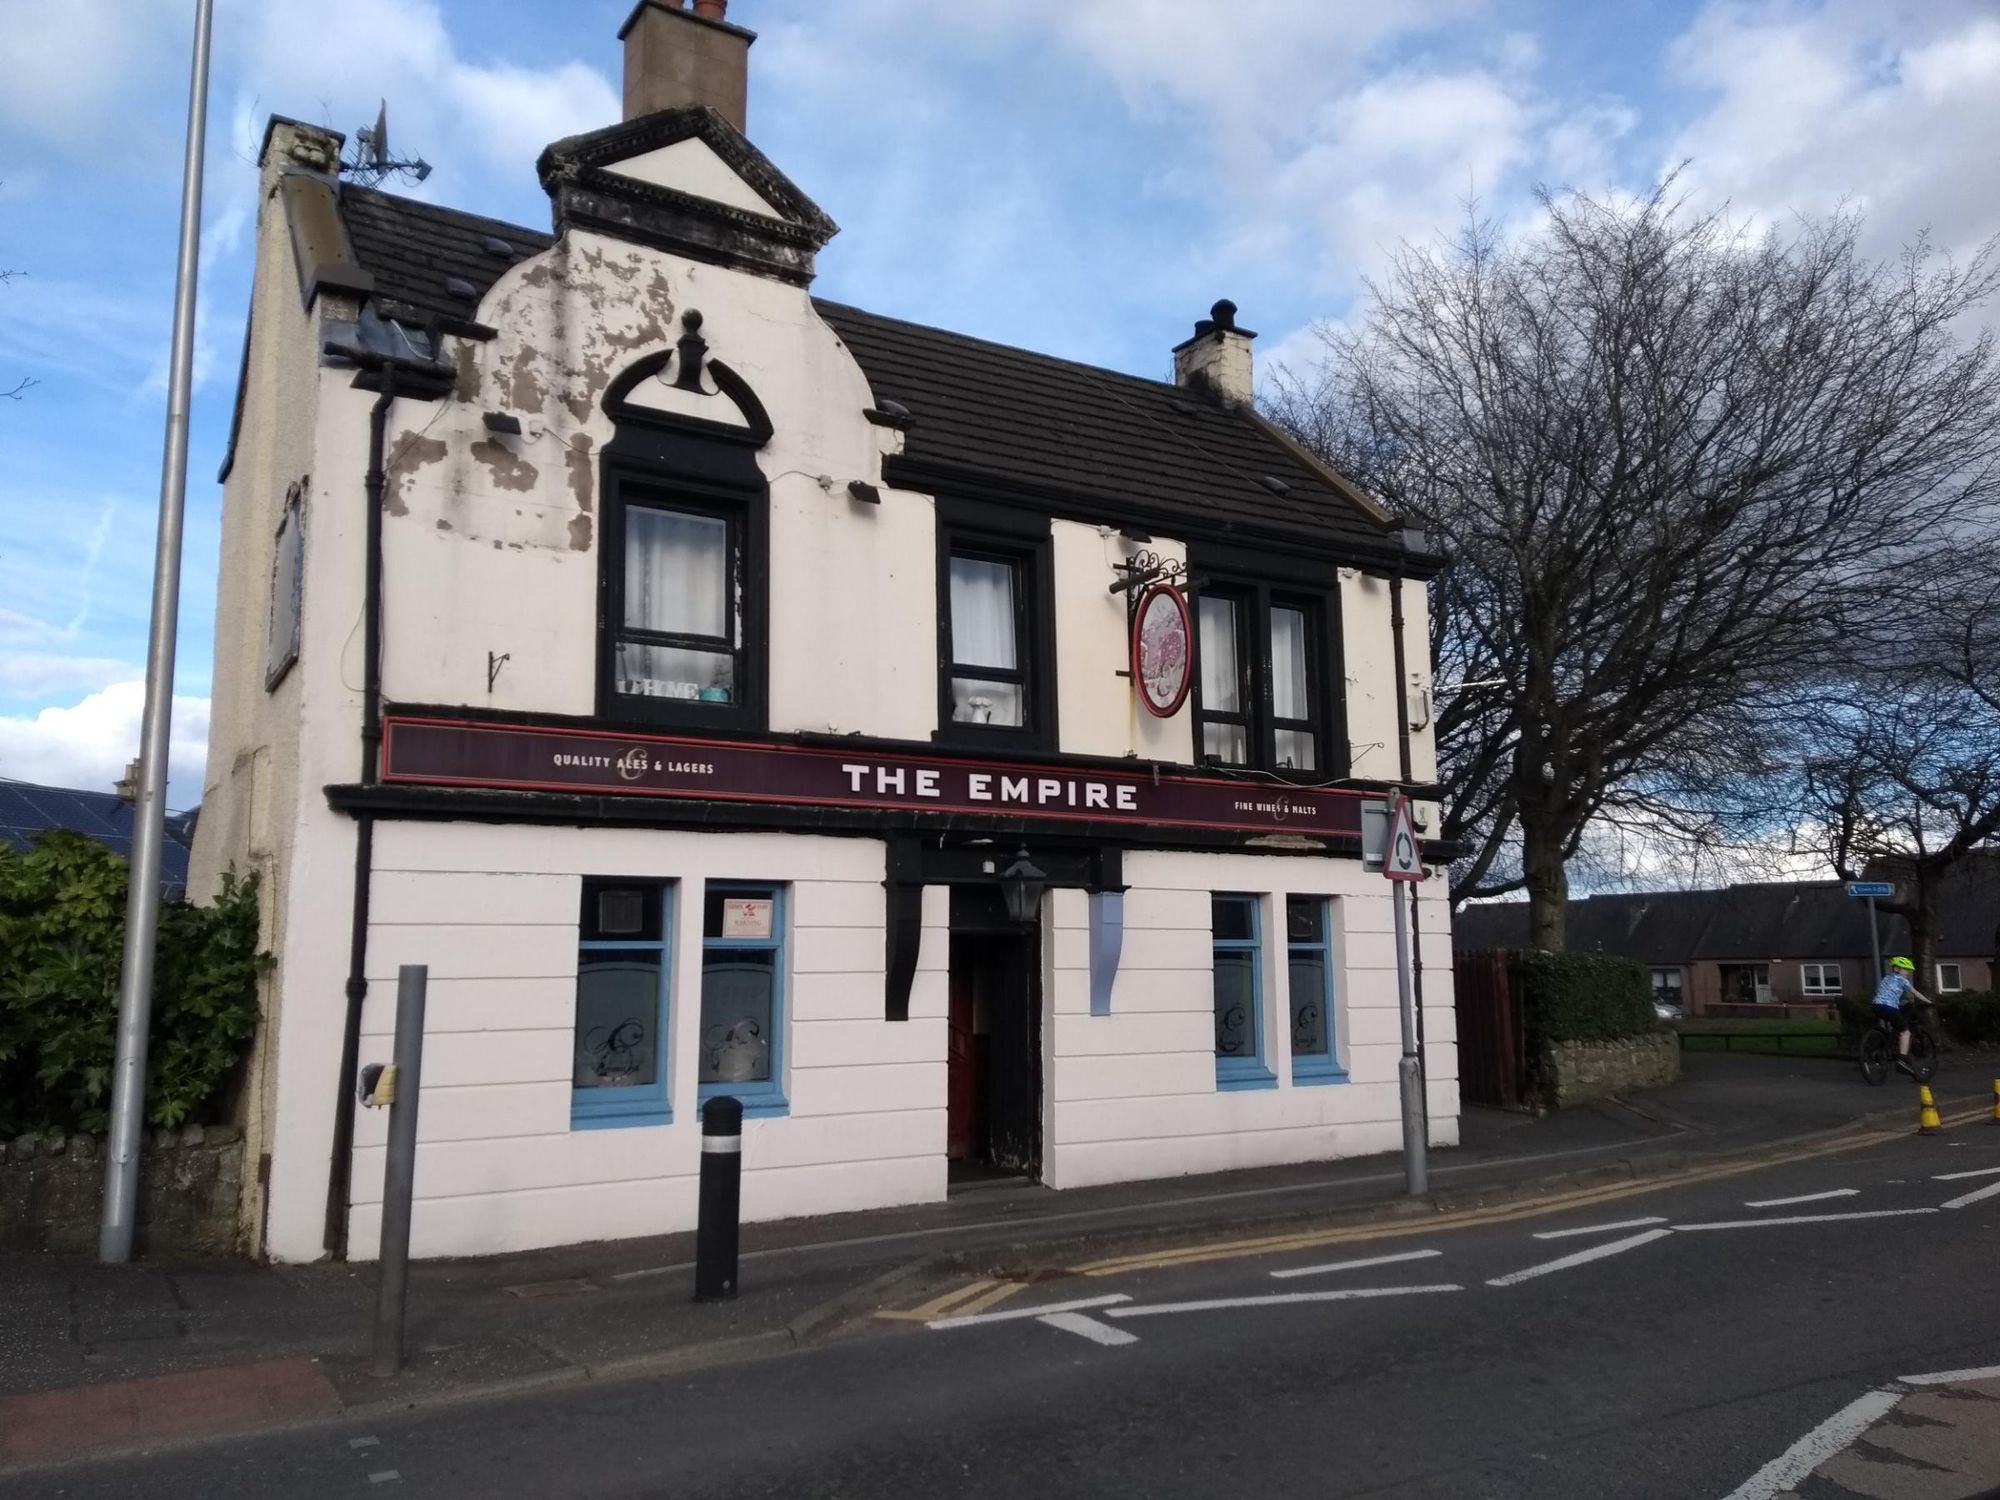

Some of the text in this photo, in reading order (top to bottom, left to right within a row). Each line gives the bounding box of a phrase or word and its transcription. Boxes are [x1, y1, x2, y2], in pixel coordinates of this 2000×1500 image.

[553, 754, 714, 774] QUALITY ALES & LAGERS
[842, 764, 1137, 810] THE EMPIRE
[1234, 801, 1317, 815] FINE WINES & MALTS
